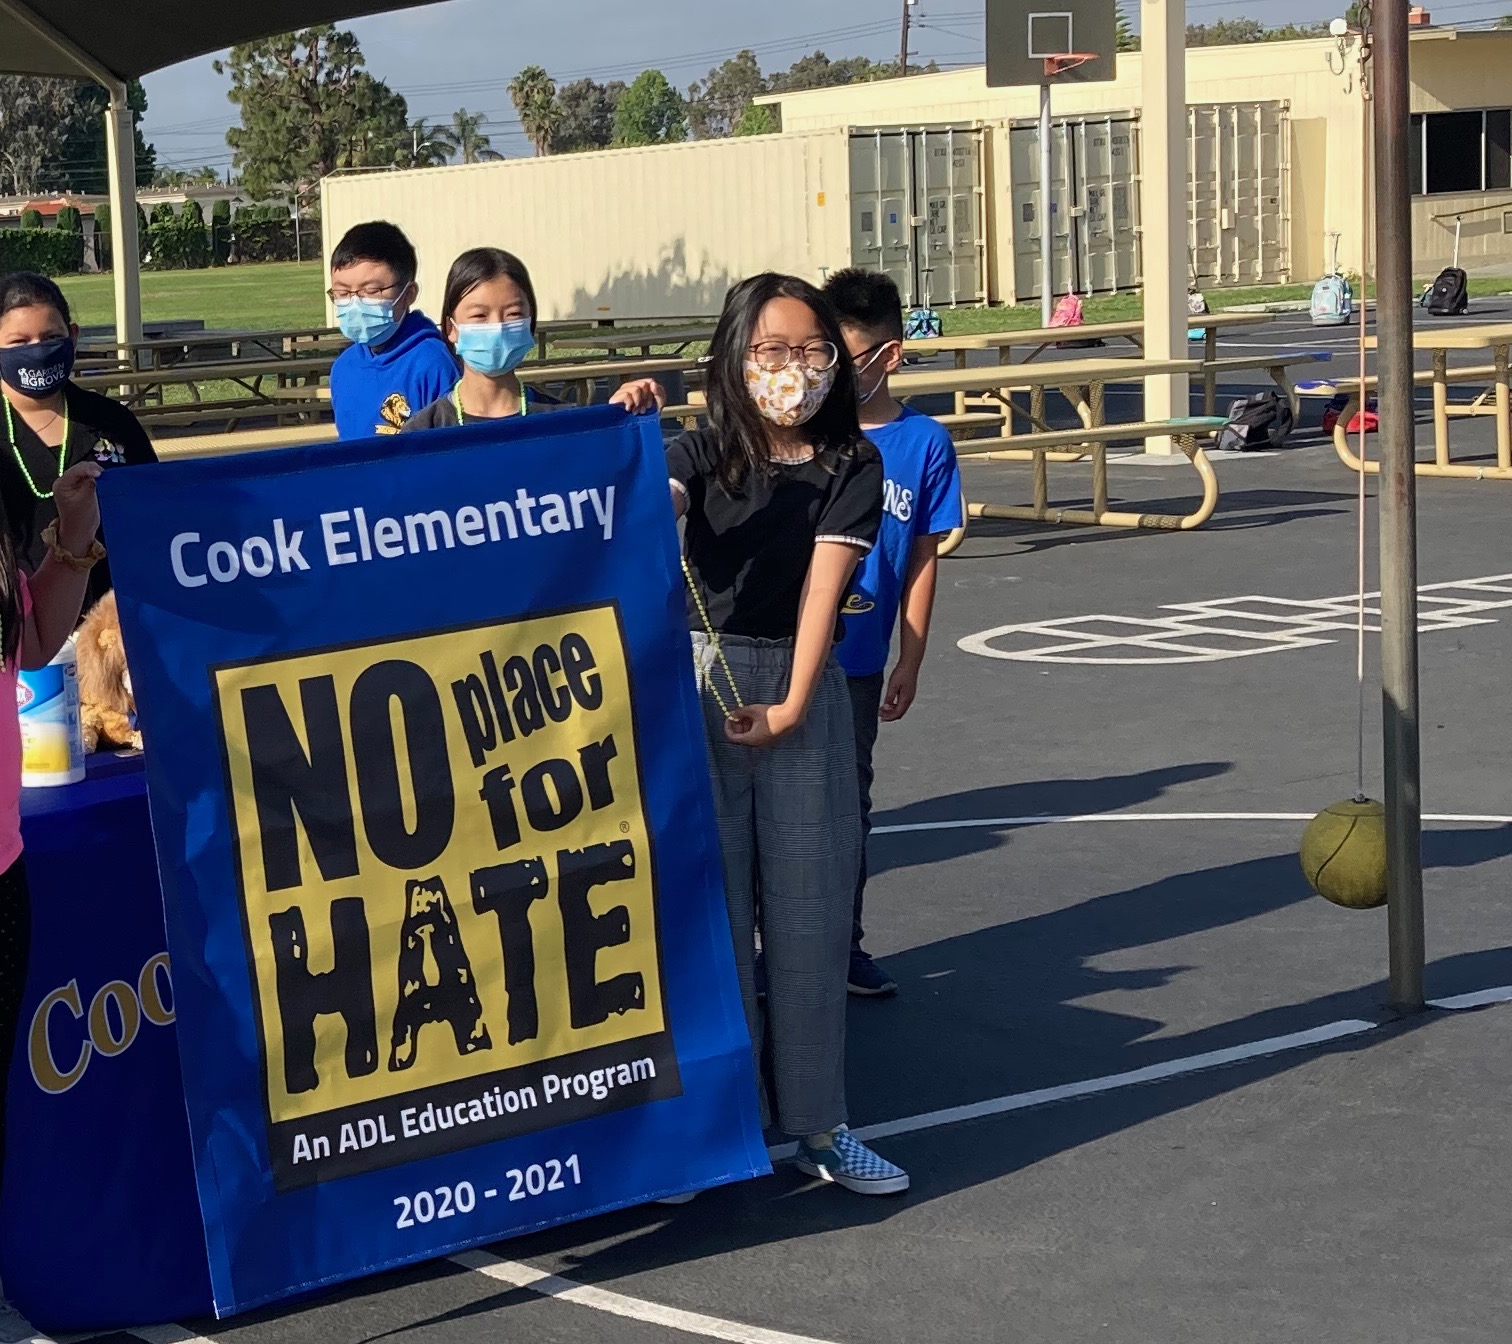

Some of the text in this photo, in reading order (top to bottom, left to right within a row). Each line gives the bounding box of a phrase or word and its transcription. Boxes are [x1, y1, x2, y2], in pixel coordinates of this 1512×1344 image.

[28, 362, 65, 378] GARDEN
[28, 369, 66, 387] GROVE
[170, 485, 616, 588] Cook Elementary
[883, 478, 913, 522] NS
[240, 659, 455, 893] NO
[450, 632, 604, 769] place
[479, 733, 618, 852] for
[268, 839, 645, 1094] HATE
[292, 1056, 656, 1164] An ADL Education Program
[393, 1180, 476, 1229] 2020
[505, 1153, 583, 1203] 2021
